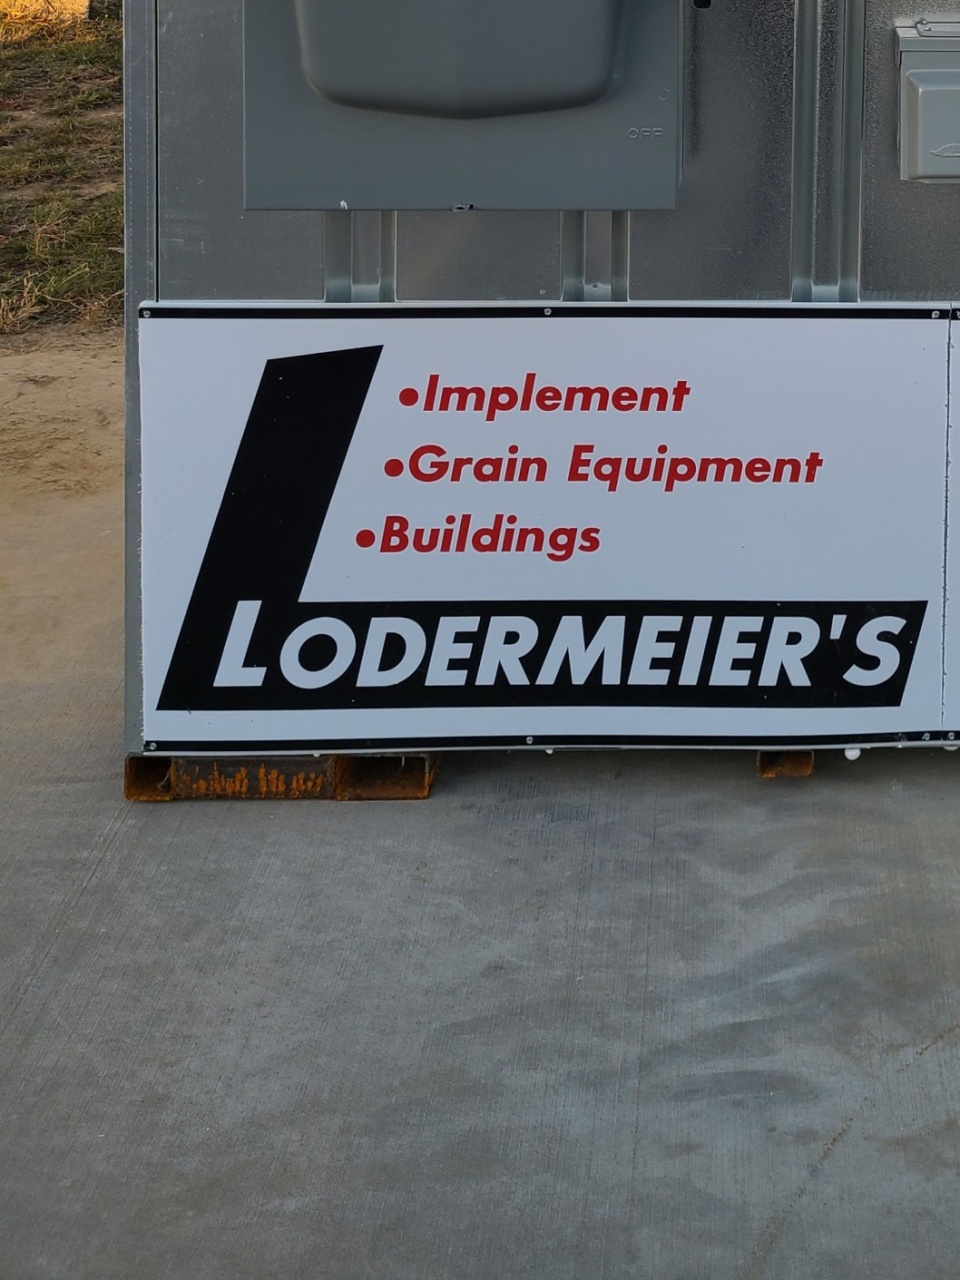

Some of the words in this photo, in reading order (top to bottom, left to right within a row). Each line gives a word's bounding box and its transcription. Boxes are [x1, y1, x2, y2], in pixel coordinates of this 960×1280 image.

[628, 127, 663, 138] OFF
[422, 372, 690, 421] Implement
[408, 444, 548, 483] Grain
[567, 444, 823, 492] Equipment
[380, 515, 602, 562] Buildings
[213, 600, 907, 689] LODERMEIER'S
